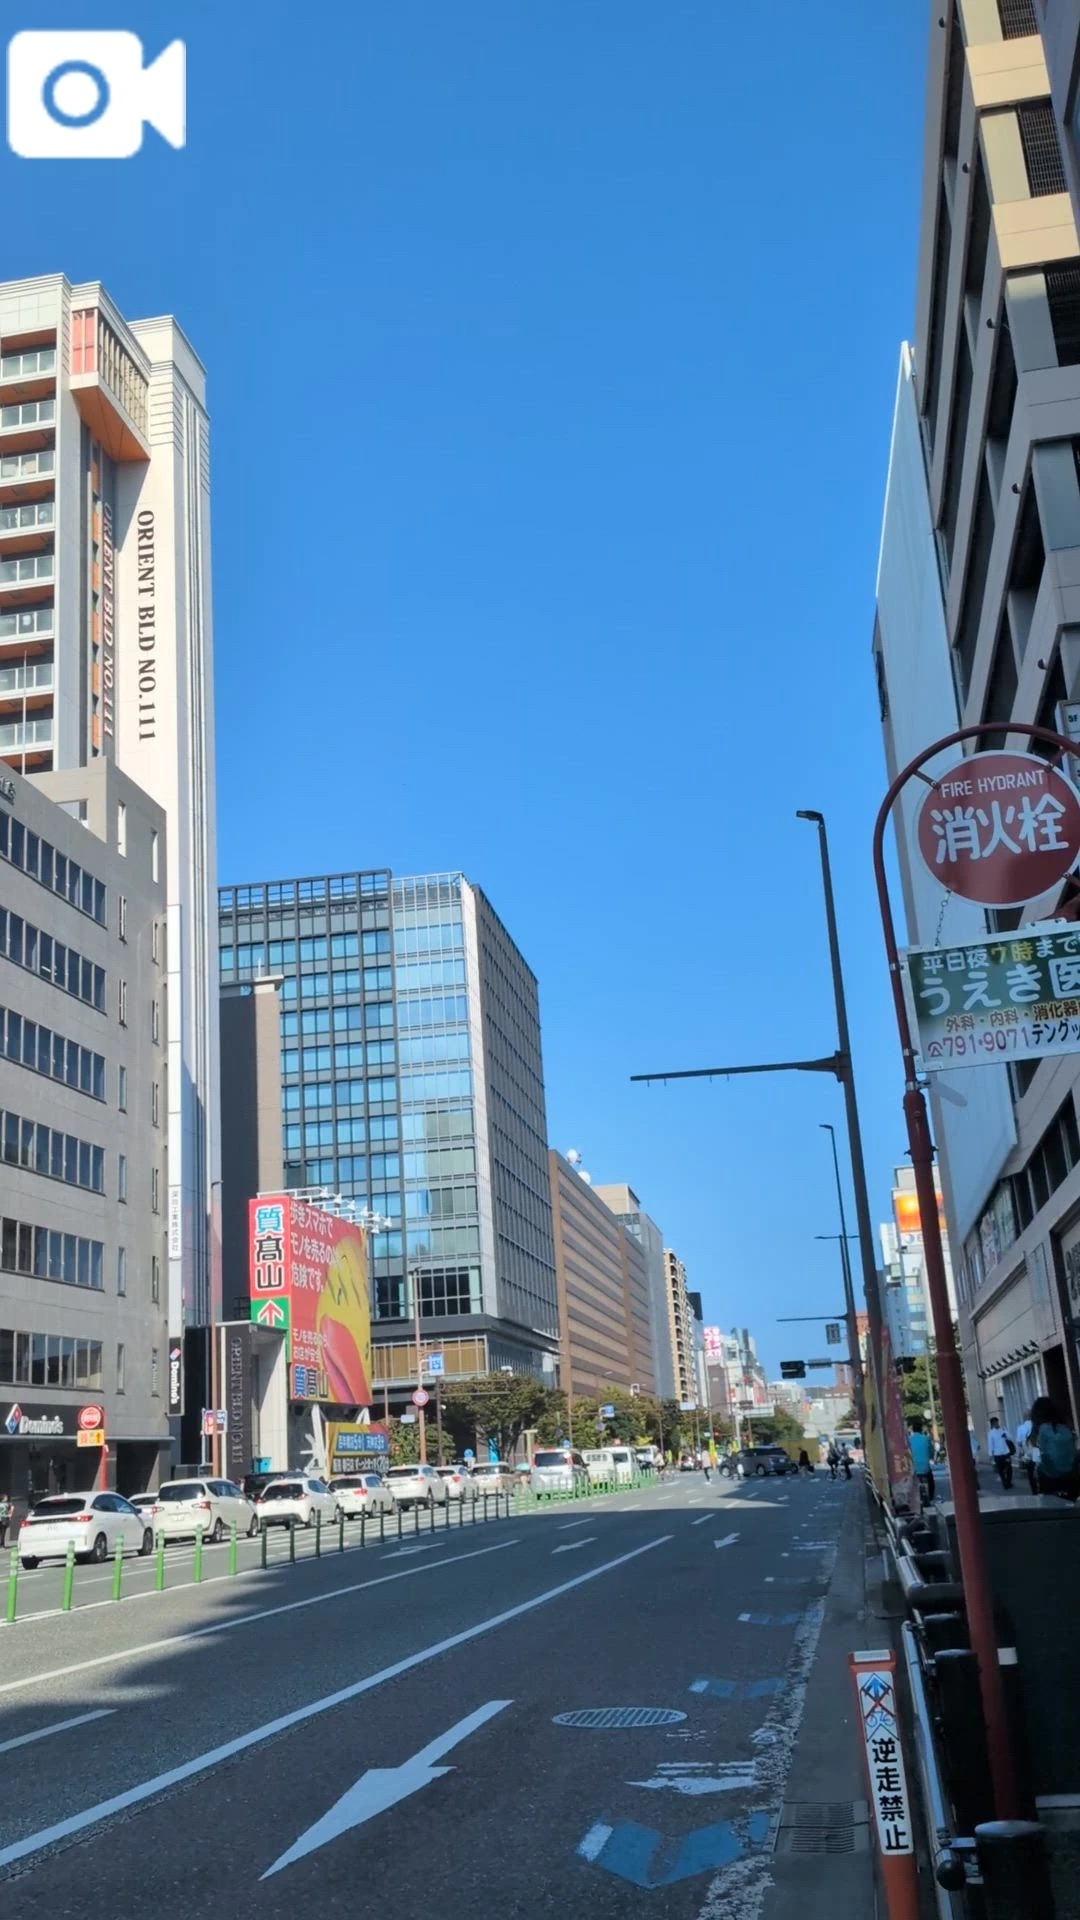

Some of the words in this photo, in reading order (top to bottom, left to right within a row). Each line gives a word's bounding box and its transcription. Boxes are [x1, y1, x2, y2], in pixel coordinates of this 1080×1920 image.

[136, 509, 154, 595] ORIENT
[137, 605, 155, 652] BLD
[138, 658, 157, 741] NO.111
[941, 780, 973, 798] FIRE
[978, 769, 1045, 793] HYDRANT
[930, 793, 1070, 864] 消火栓
[922, 935, 1080, 975] 平日夜7時まで
[170, 1361, 180, 1405] Domino's
[19, 1415, 64, 1434] Domino's
[871, 1737, 909, 1851] 逆走禁止
